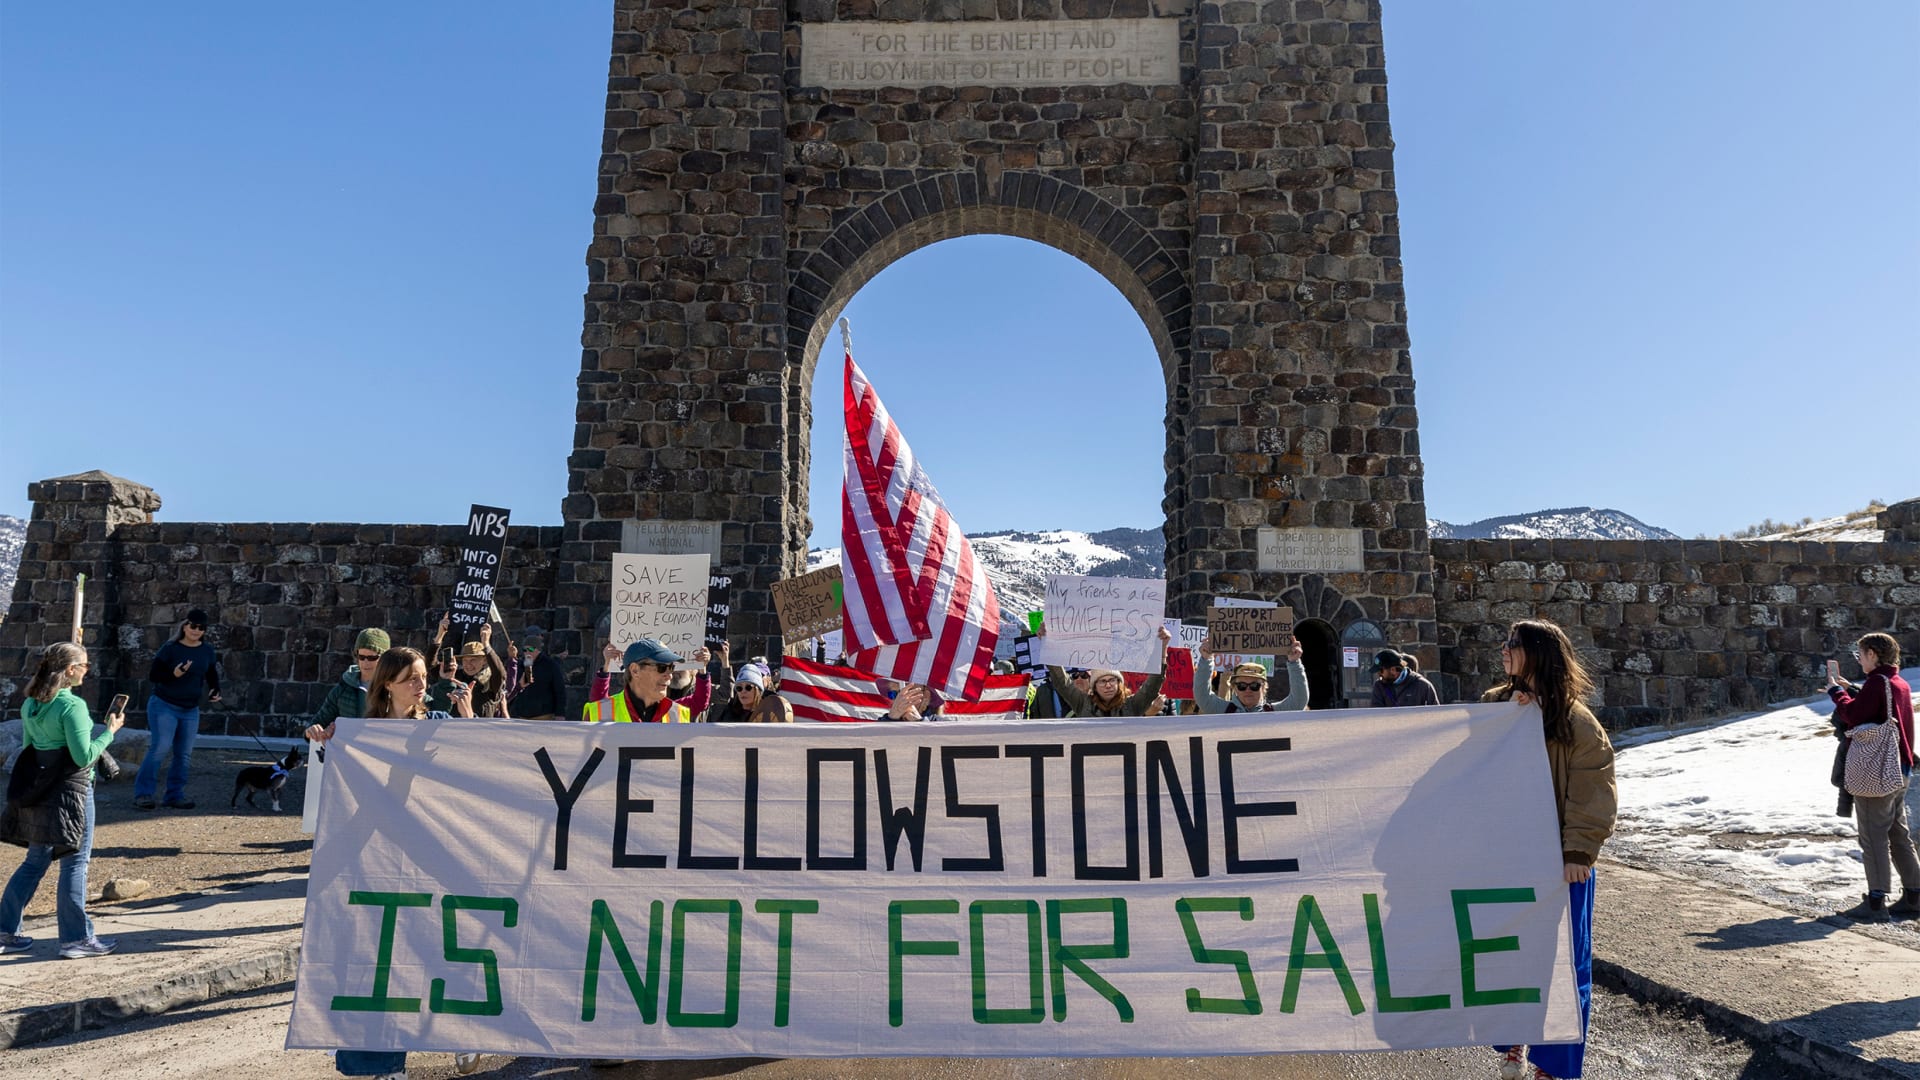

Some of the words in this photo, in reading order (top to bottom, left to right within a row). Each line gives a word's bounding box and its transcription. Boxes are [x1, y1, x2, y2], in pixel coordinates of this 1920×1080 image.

[920, 32, 960, 52] THE
[970, 31, 1063, 51] BENEFIT
[1069, 30, 1116, 49] AND
[827, 60, 960, 81] ENJOYMENT
[970, 60, 1005, 79] OF
[1010, 60, 1054, 79] THE
[469, 512, 508, 538] NPS
[635, 525, 711, 535] YELLOWSTONE
[648, 537, 695, 548] NATIONAL
[1278, 533, 1322, 543] CREATED
[1328, 532, 1344, 542] BY
[463, 548, 497, 565] INTO
[1264, 545, 1282, 556] ACT
[1286, 545, 1299, 556] OF
[1303, 545, 1357, 557] CONGRESS
[466, 566, 490, 579] THE
[1275, 559, 1310, 570] MARCH
[622, 564, 684, 585] SAVE
[708, 576, 732, 589] UMP
[455, 581, 494, 601] FUTURE
[616, 589, 653, 605] OUR
[659, 589, 708, 607] PARKS
[1047, 578, 1069, 606] My
[1079, 582, 1120, 600] friends
[1127, 587, 1162, 602] are
[474, 604, 488, 613] ALL
[713, 604, 730, 616] USA
[781, 592, 832, 616] AMERICA
[452, 613, 486, 625] STAFF
[616, 610, 648, 626] OUR
[787, 605, 825, 626] GREAT
[1218, 608, 1276, 620] SUPPORT
[1050, 606, 1154, 642] HOMELESS
[1208, 621, 1250, 633] FEDERAL
[1254, 621, 1292, 633] EMPLOYEES
[659, 632, 696, 647] OUR
[1180, 626, 1208, 643] ROTE
[1212, 632, 1240, 651] NOT
[1068, 650, 1125, 666] now
[533, 736, 1300, 881] YELLOWSTONE
[330, 890, 519, 1017] IS
[581, 898, 820, 1030] NOT
[888, 896, 1136, 1028] FOR
[1174, 886, 1543, 1017] SALE
